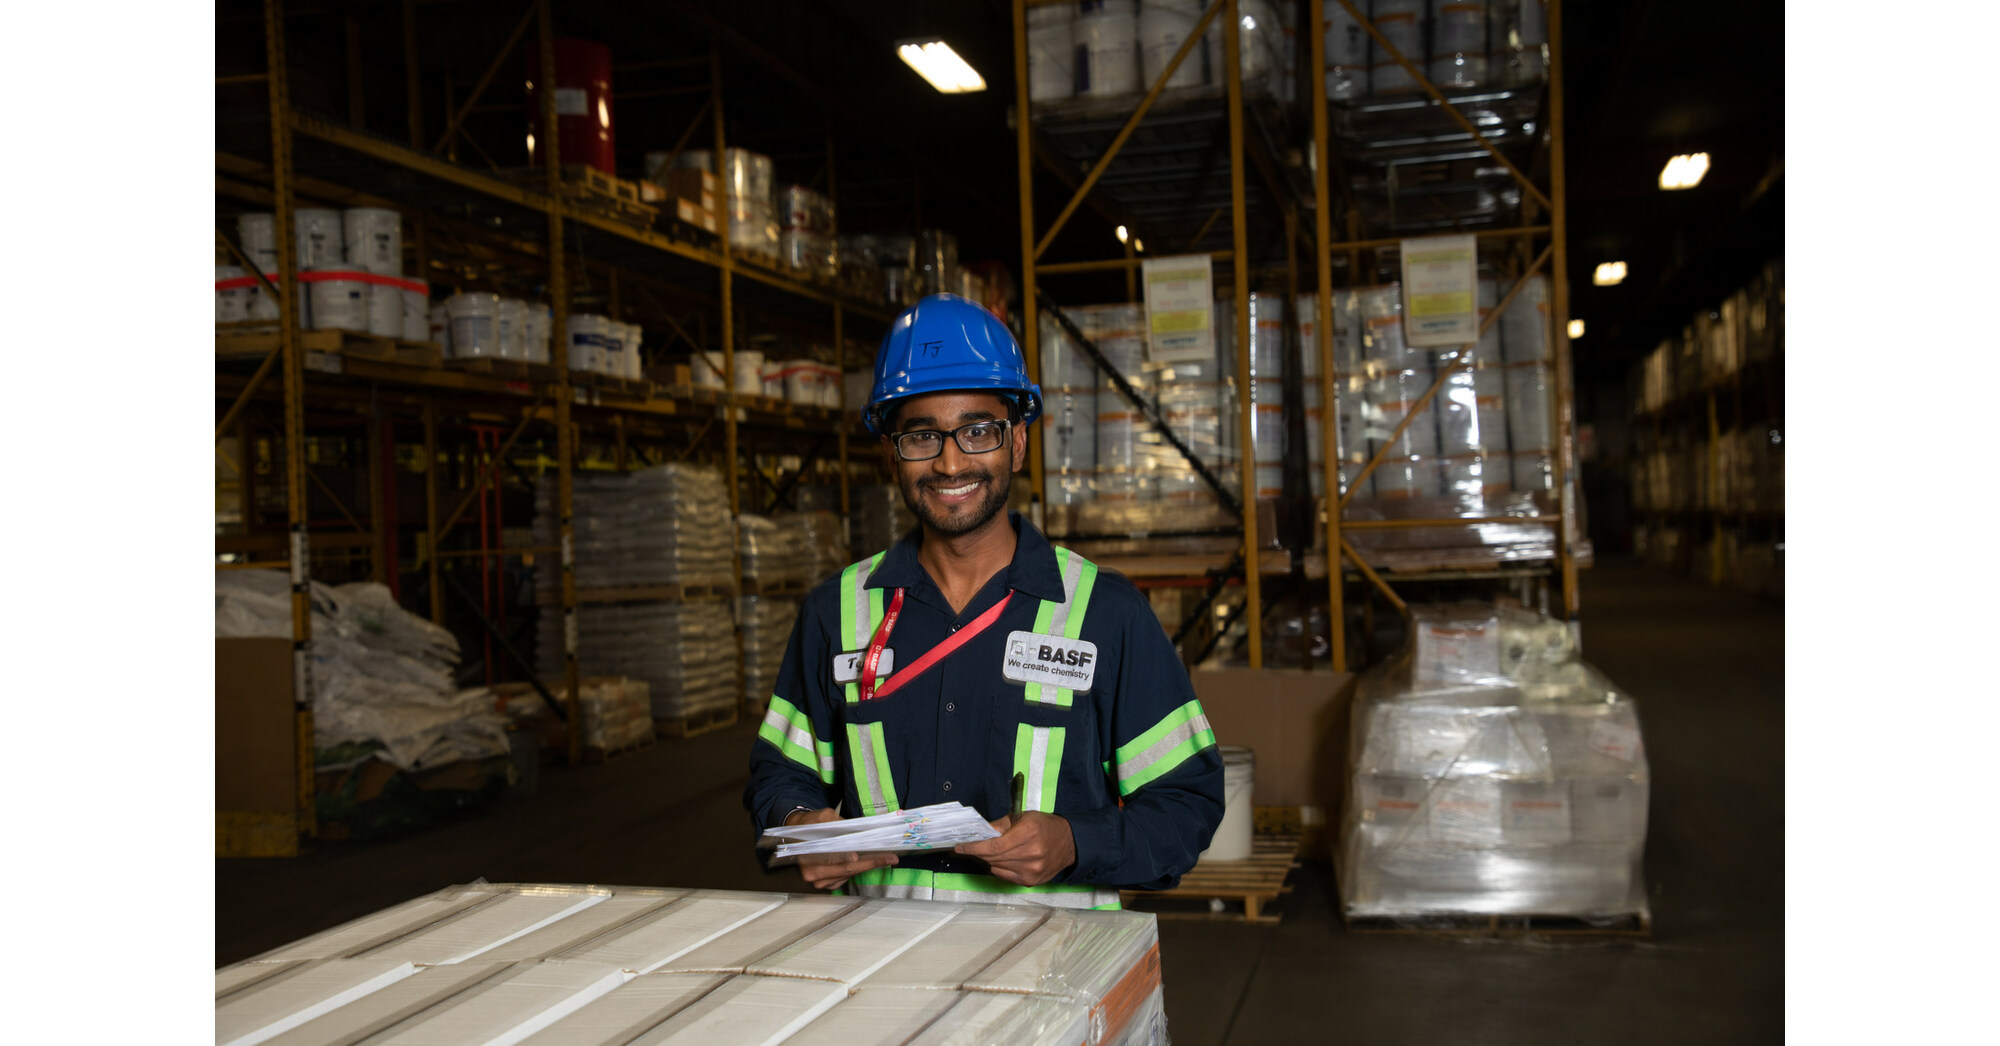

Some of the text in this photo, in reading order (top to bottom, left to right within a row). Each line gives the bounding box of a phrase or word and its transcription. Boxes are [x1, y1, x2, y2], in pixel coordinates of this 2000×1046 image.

[870, 653, 879, 671] BASF
[1038, 645, 1093, 667] BASF
[1008, 658, 1090, 681] We create chemistry
